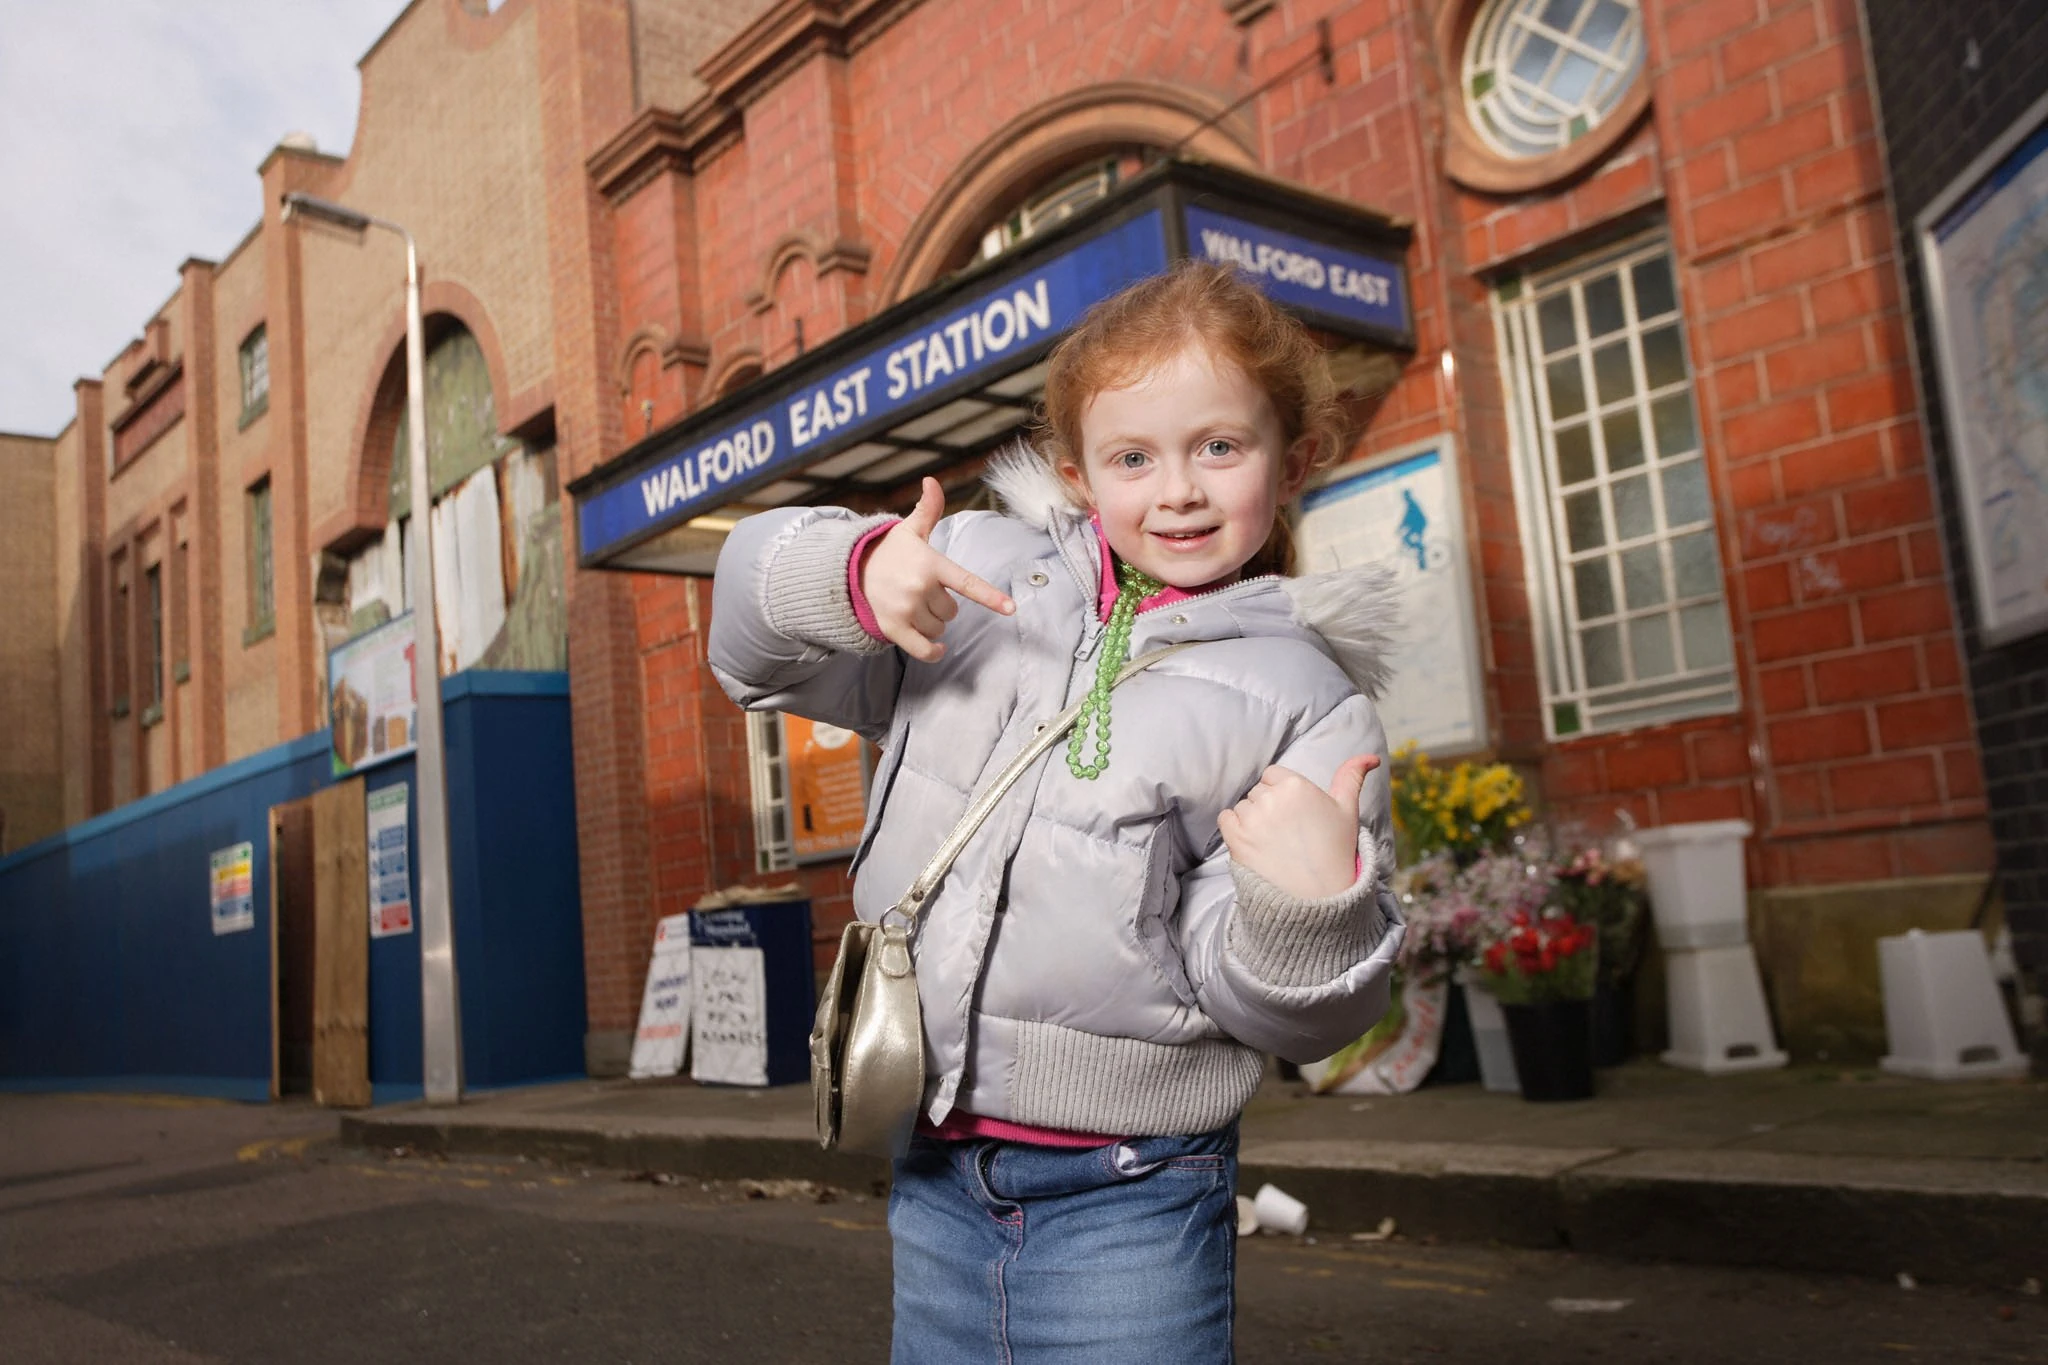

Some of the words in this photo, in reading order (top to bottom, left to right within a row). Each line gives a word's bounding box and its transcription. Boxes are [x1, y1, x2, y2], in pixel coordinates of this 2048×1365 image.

[1202, 230, 1325, 289] WALFORD
[1328, 265, 1390, 306] EAST
[641, 420, 775, 516] WALFORD
[789, 368, 871, 446] EAST
[886, 280, 1050, 399] STATION
